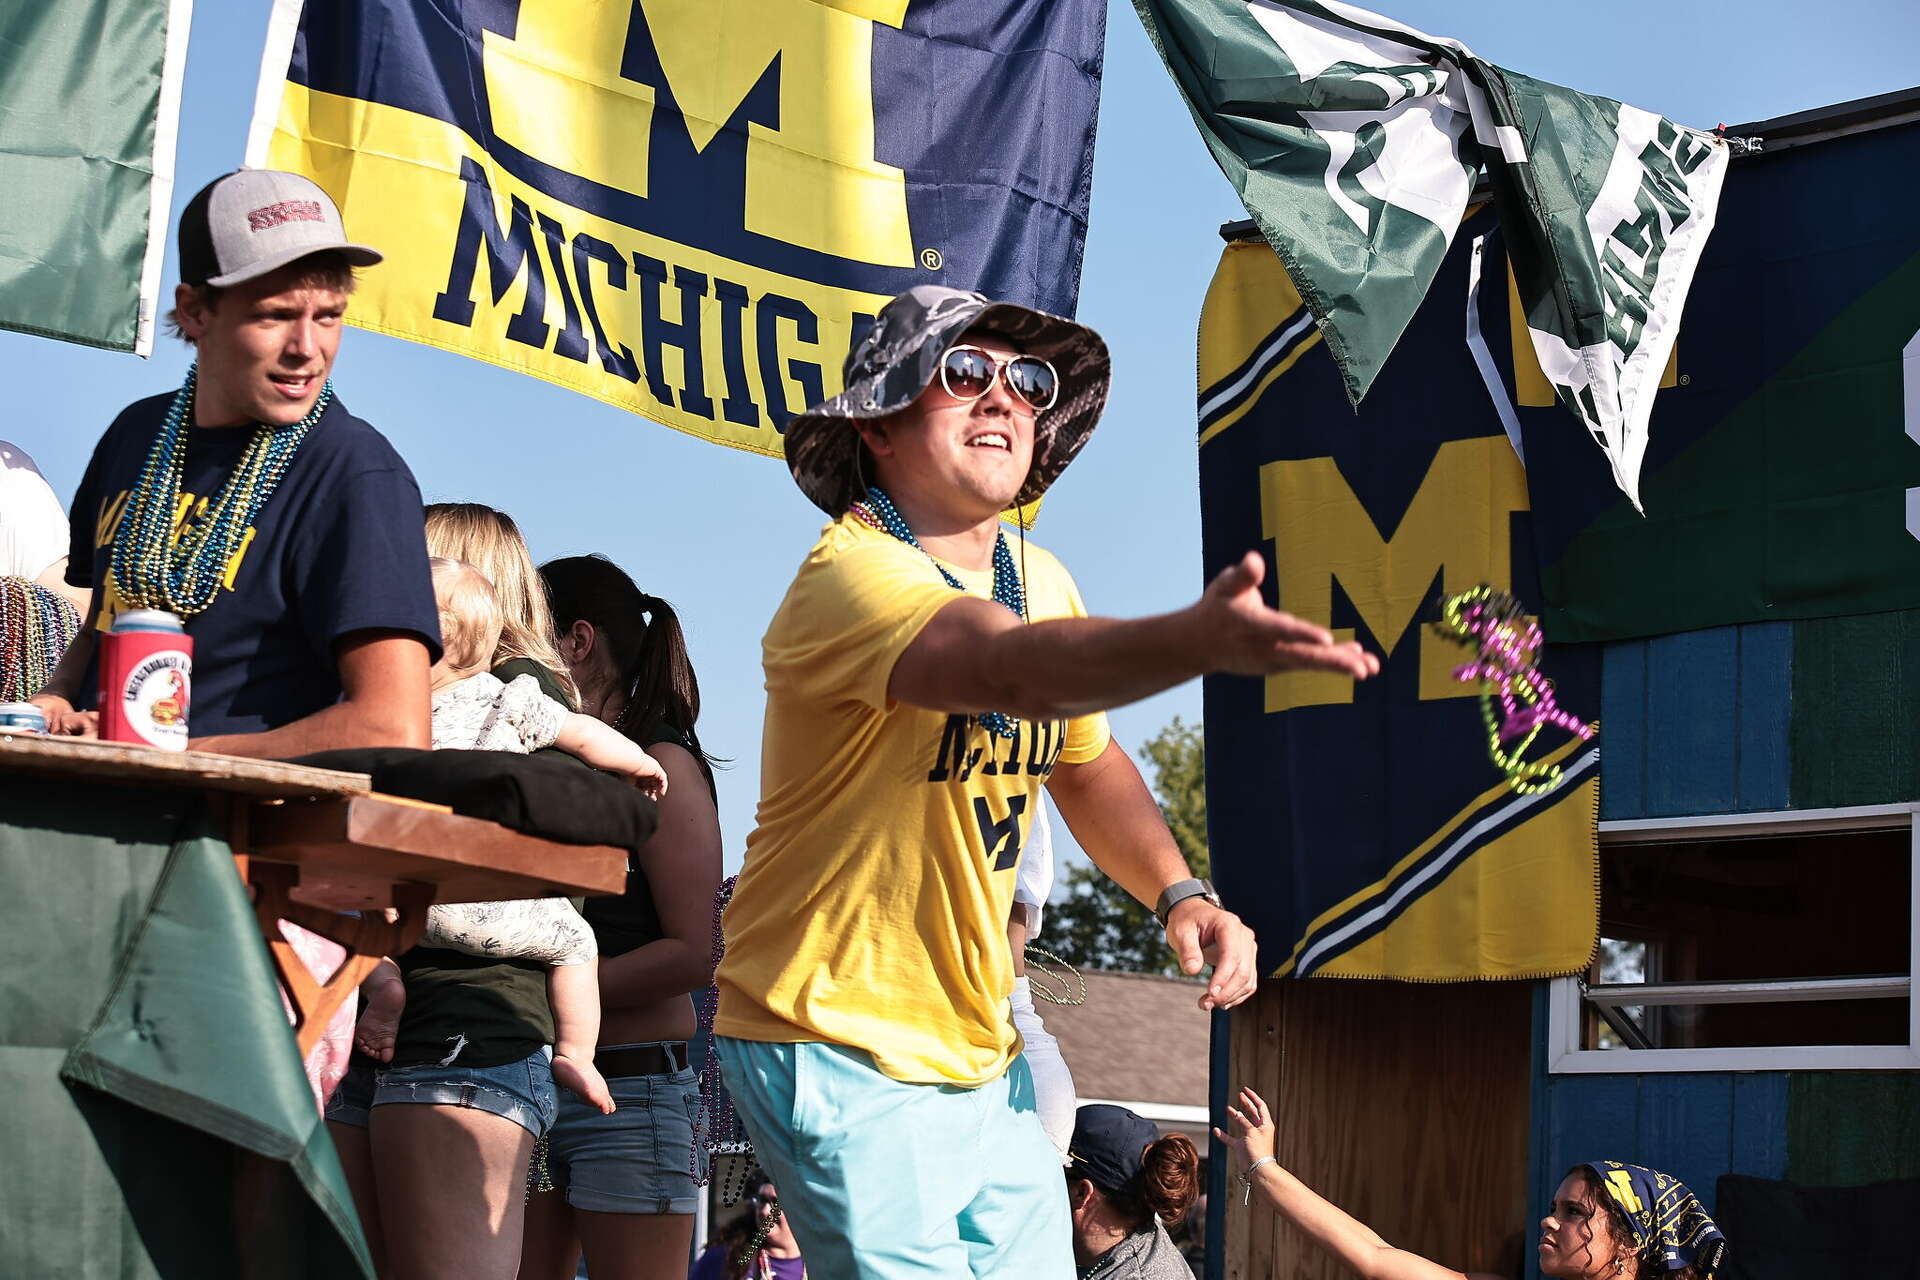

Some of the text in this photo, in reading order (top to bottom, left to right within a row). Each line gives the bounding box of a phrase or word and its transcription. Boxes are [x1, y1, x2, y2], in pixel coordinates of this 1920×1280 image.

[481, 0, 916, 269] M
[432, 154, 881, 435] MICHIG
[1259, 434, 1541, 714] M
